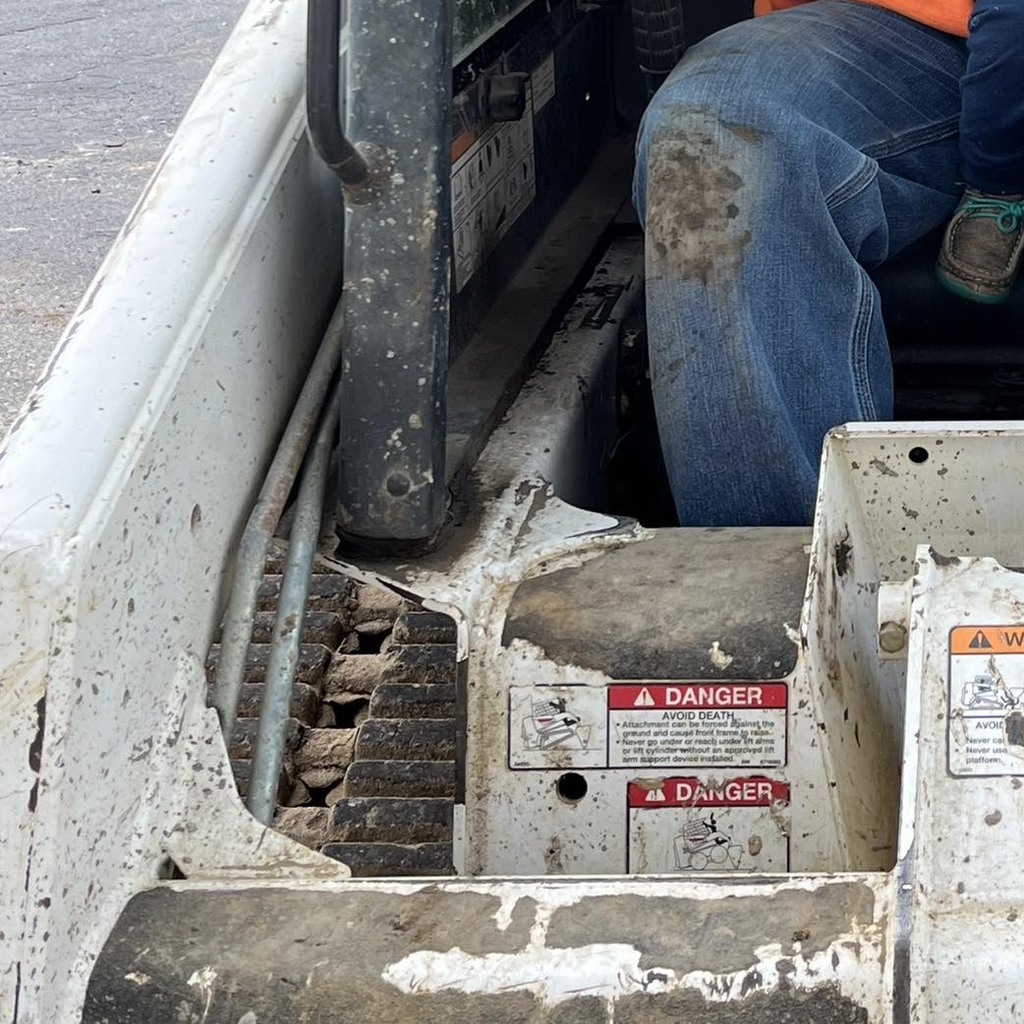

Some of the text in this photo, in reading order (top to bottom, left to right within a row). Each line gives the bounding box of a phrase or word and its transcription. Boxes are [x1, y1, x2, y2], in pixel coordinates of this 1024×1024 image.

[665, 687, 763, 706] DANGER
[661, 711, 735, 721] AVOID DEATH
[622, 720, 670, 728] Attachment
[689, 720, 700, 728] be
[701, 720, 728, 728] forced
[730, 720, 760, 729] against
[761, 720, 775, 728] the
[622, 729, 652, 738] ground
[652, 729, 669, 737] and
[695, 729, 714, 737] front
[622, 738, 646, 746] Never
[646, 739, 659, 747] go
[694, 737, 718, 745] reach
[718, 737, 742, 745] under
[743, 737, 754, 745] lift
[622, 747, 631, 755] or
[632, 747, 644, 755] lift
[645, 747, 677, 755] cylinder
[679, 746, 710, 754] without
[724, 746, 763, 755] approved
[763, 746, 775, 754] lift
[965, 746, 991, 754] Never
[639, 756, 671, 764] support
[672, 755, 699, 763] device
[676, 782, 773, 801] DANGER
